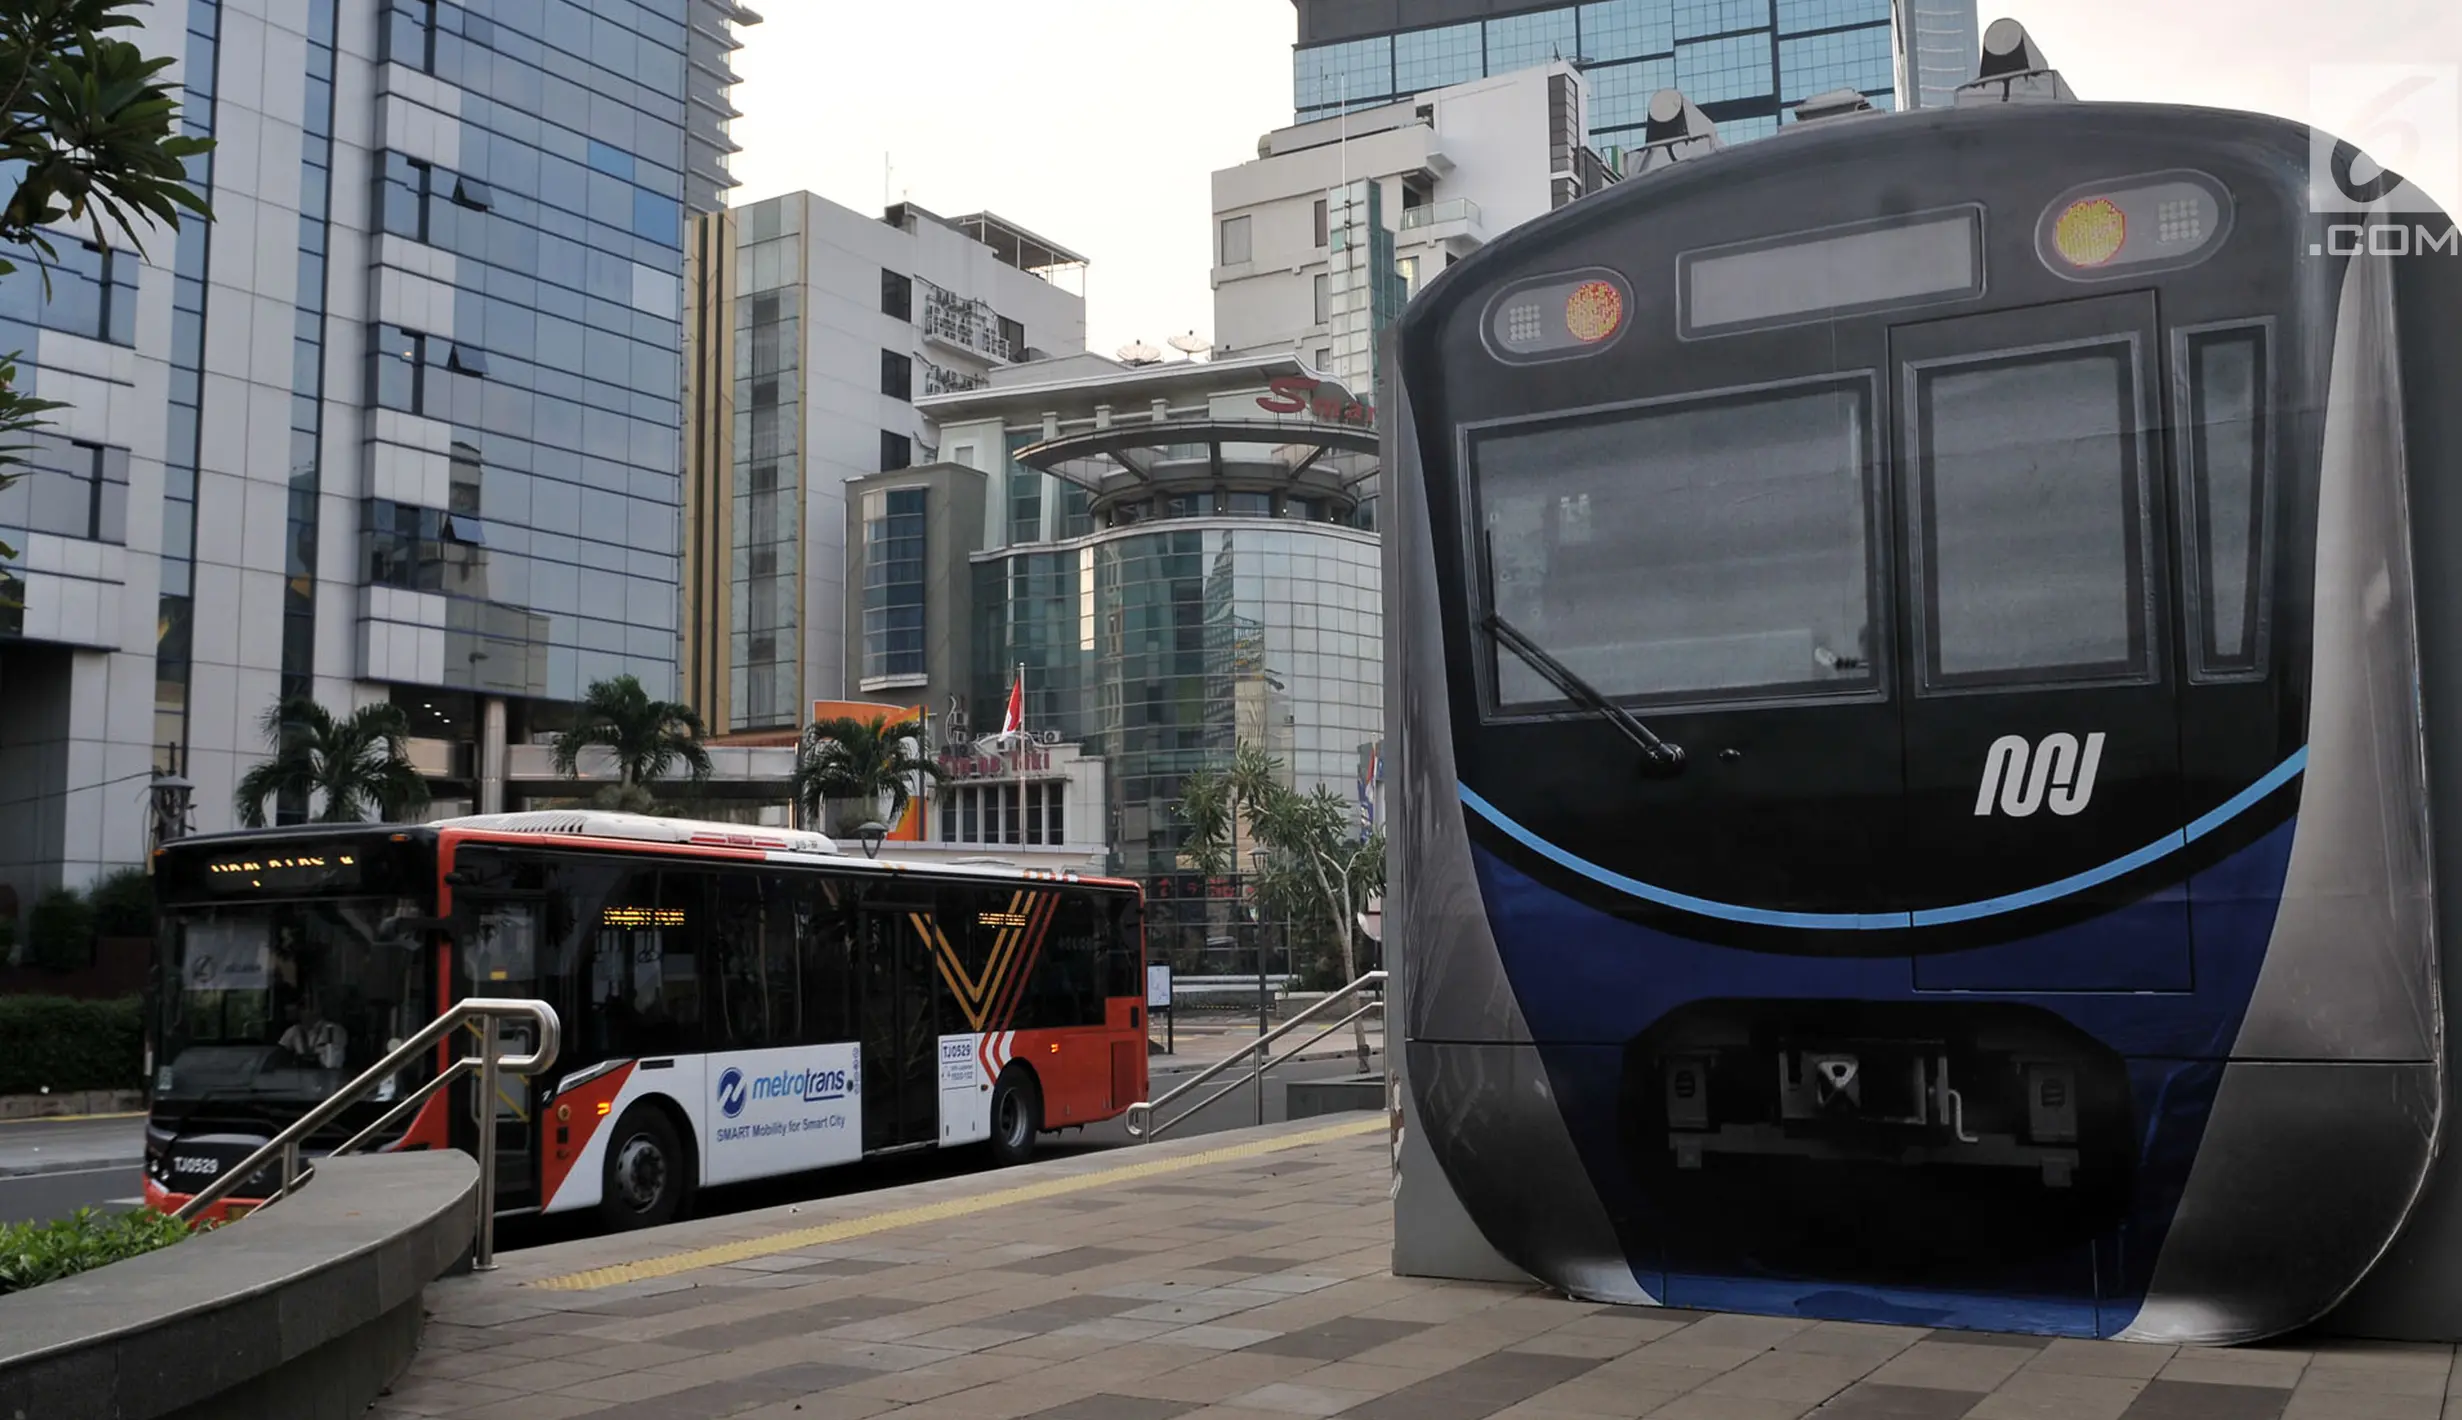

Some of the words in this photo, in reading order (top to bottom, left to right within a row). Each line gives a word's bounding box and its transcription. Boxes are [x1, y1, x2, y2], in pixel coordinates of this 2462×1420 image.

[943, 1043, 971, 1058] TJ0529
[752, 1068, 845, 1102] metrotrans
[717, 1125, 750, 1142] SMART
[752, 1120, 787, 1137] Mobility
[788, 1119, 801, 1133] for
[803, 1116, 828, 1130] Smart
[829, 1114, 846, 1129] City
[174, 1156, 218, 1174] TJ0529
